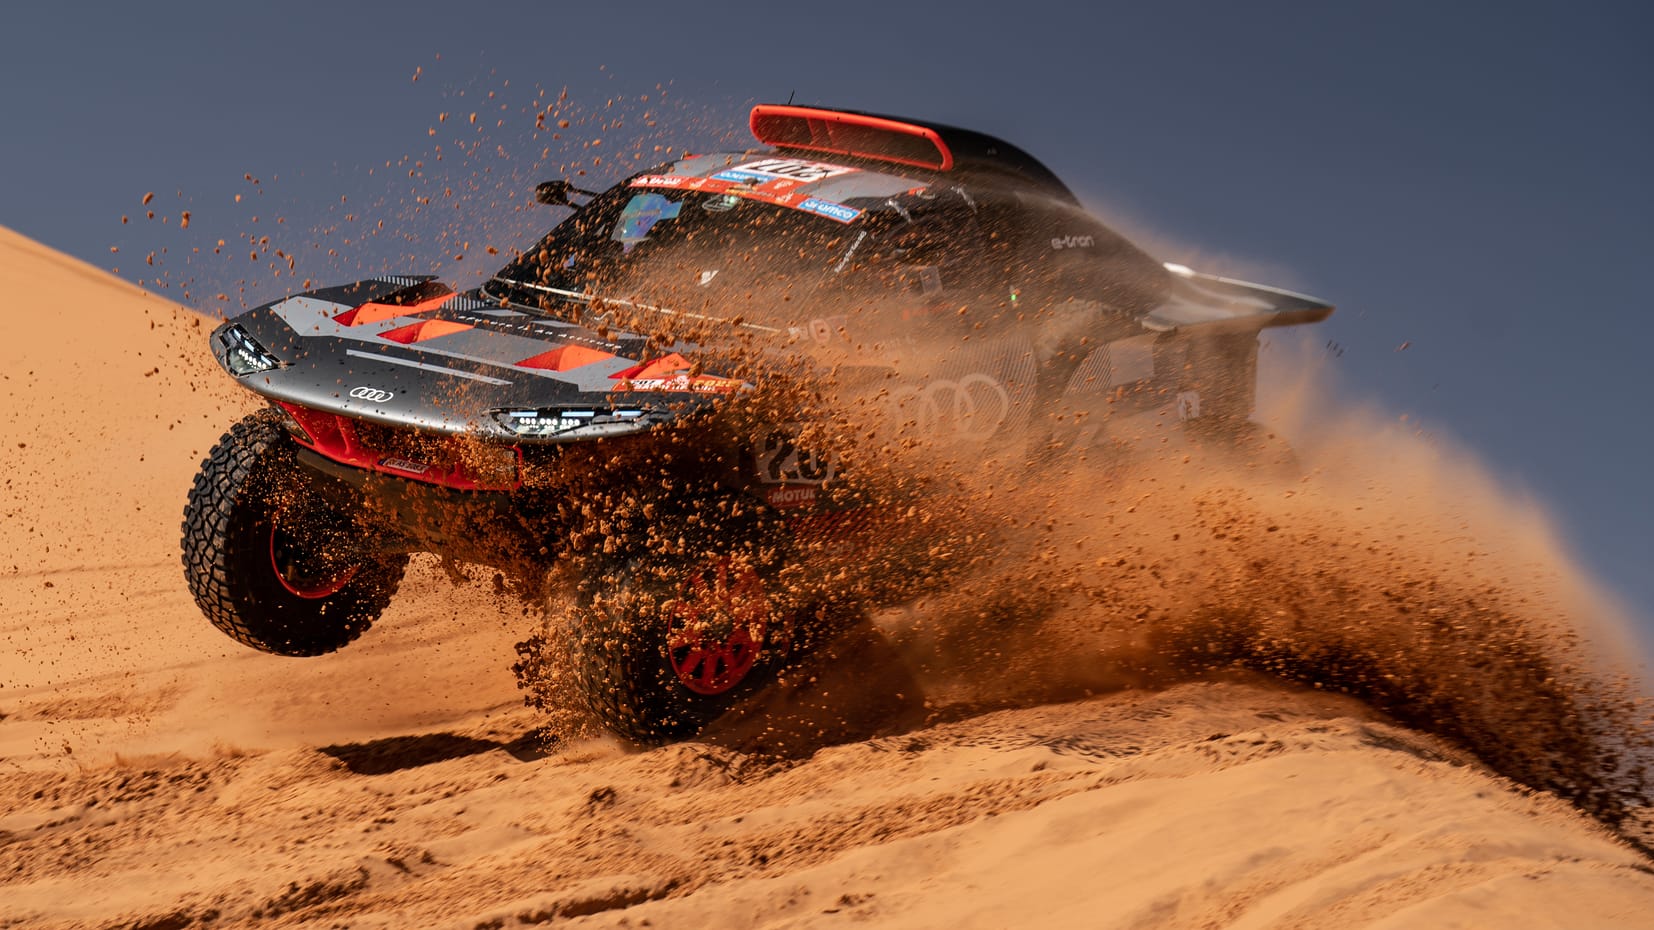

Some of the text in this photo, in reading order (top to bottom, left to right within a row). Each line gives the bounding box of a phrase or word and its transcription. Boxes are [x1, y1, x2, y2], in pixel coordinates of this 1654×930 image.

[804, 199, 854, 219] aramco
[1051, 234, 1096, 250] e-tron
[771, 488, 816, 504] MOTUL
